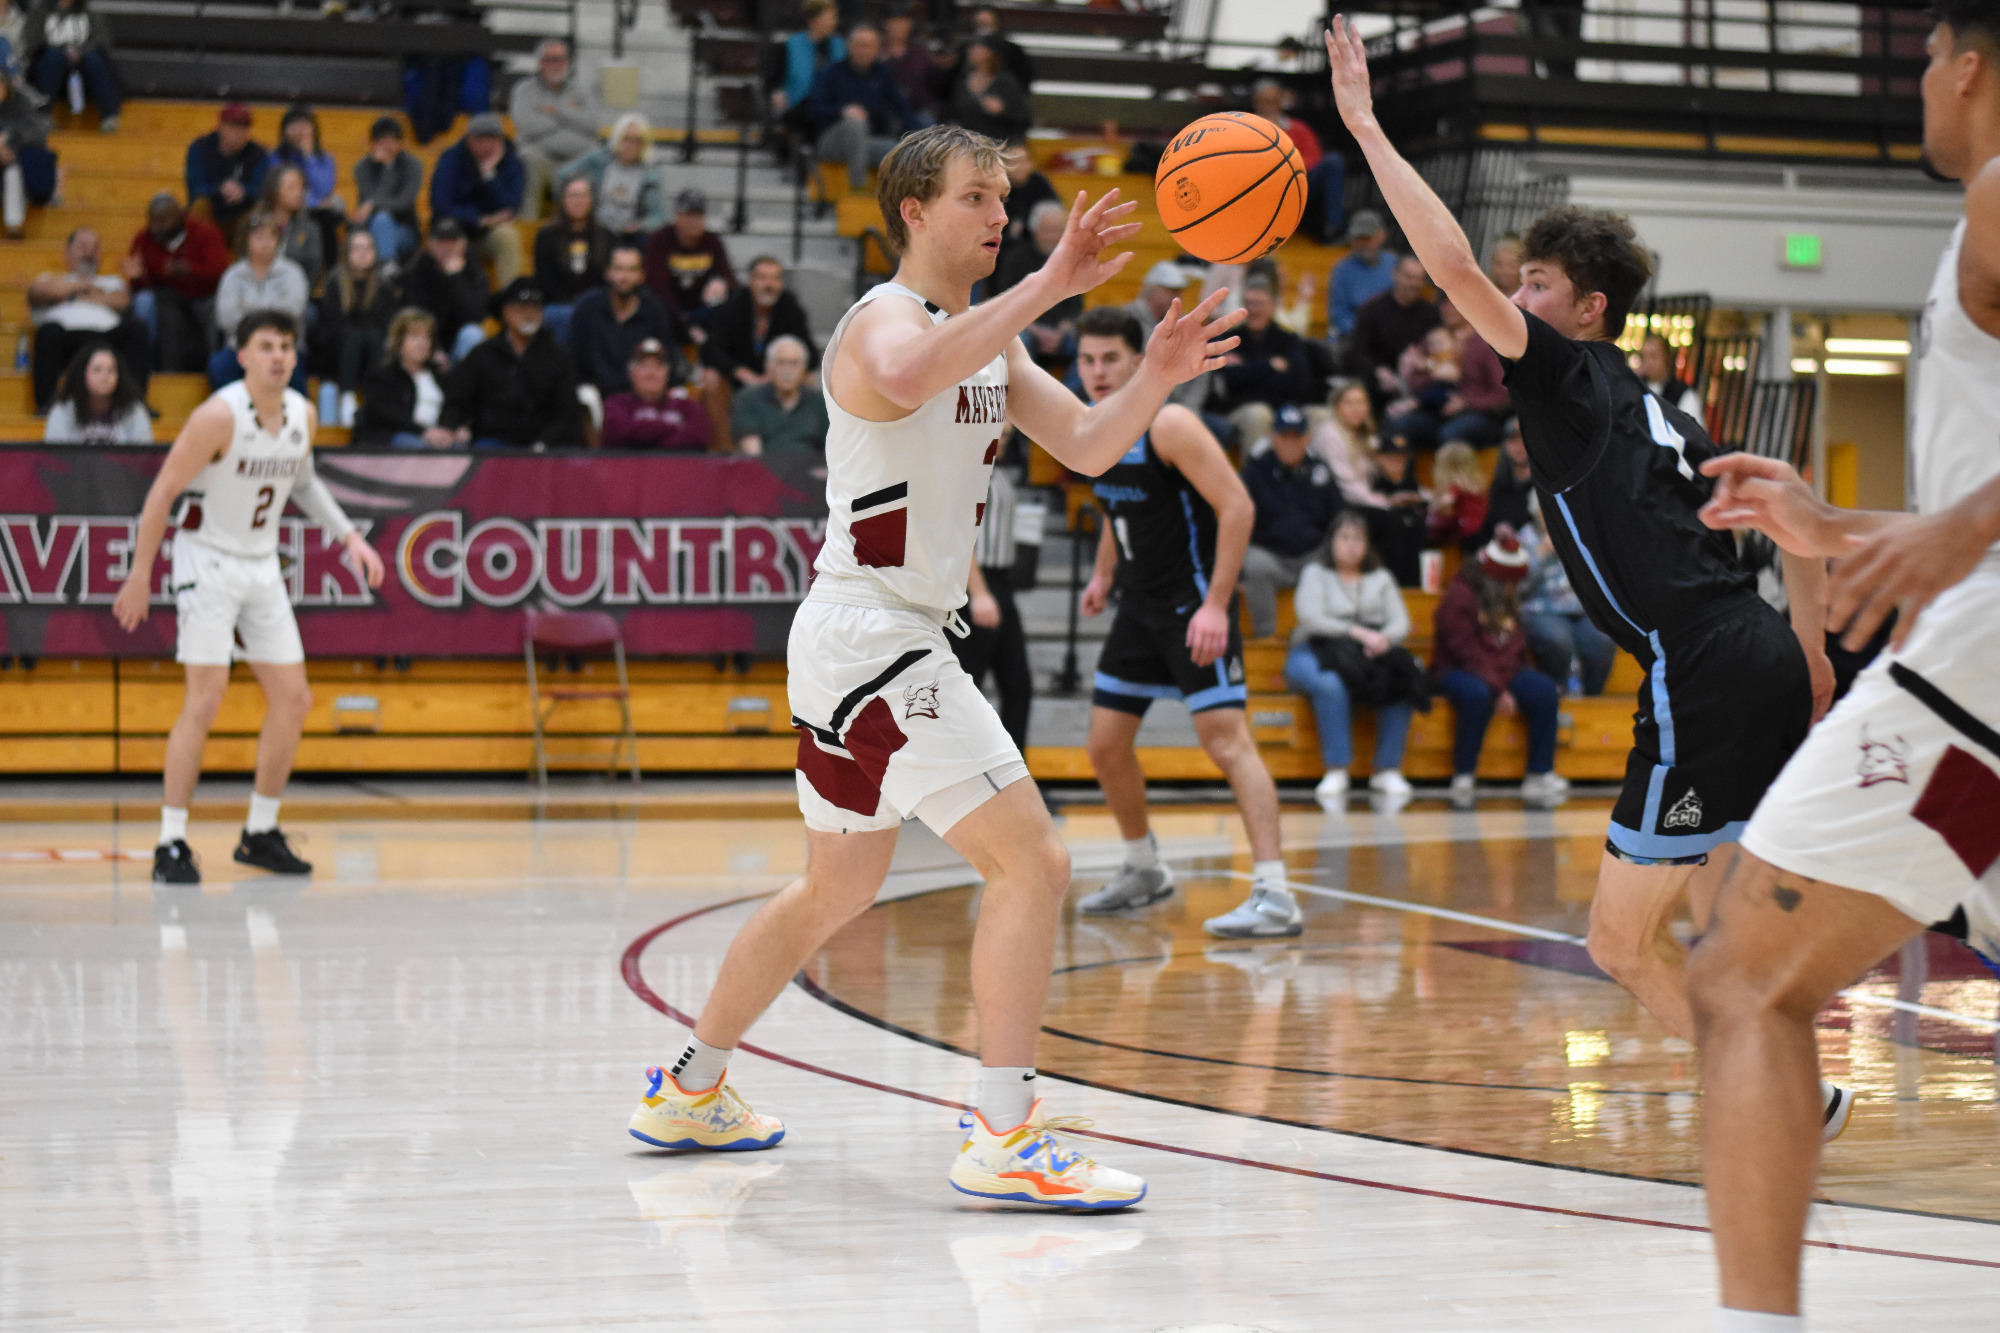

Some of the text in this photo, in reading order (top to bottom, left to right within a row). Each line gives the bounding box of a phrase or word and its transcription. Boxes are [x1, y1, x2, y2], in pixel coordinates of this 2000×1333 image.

[1160, 128, 1207, 165] EVO
[250, 485, 276, 530] 2
[1663, 809, 1702, 829] CCU
